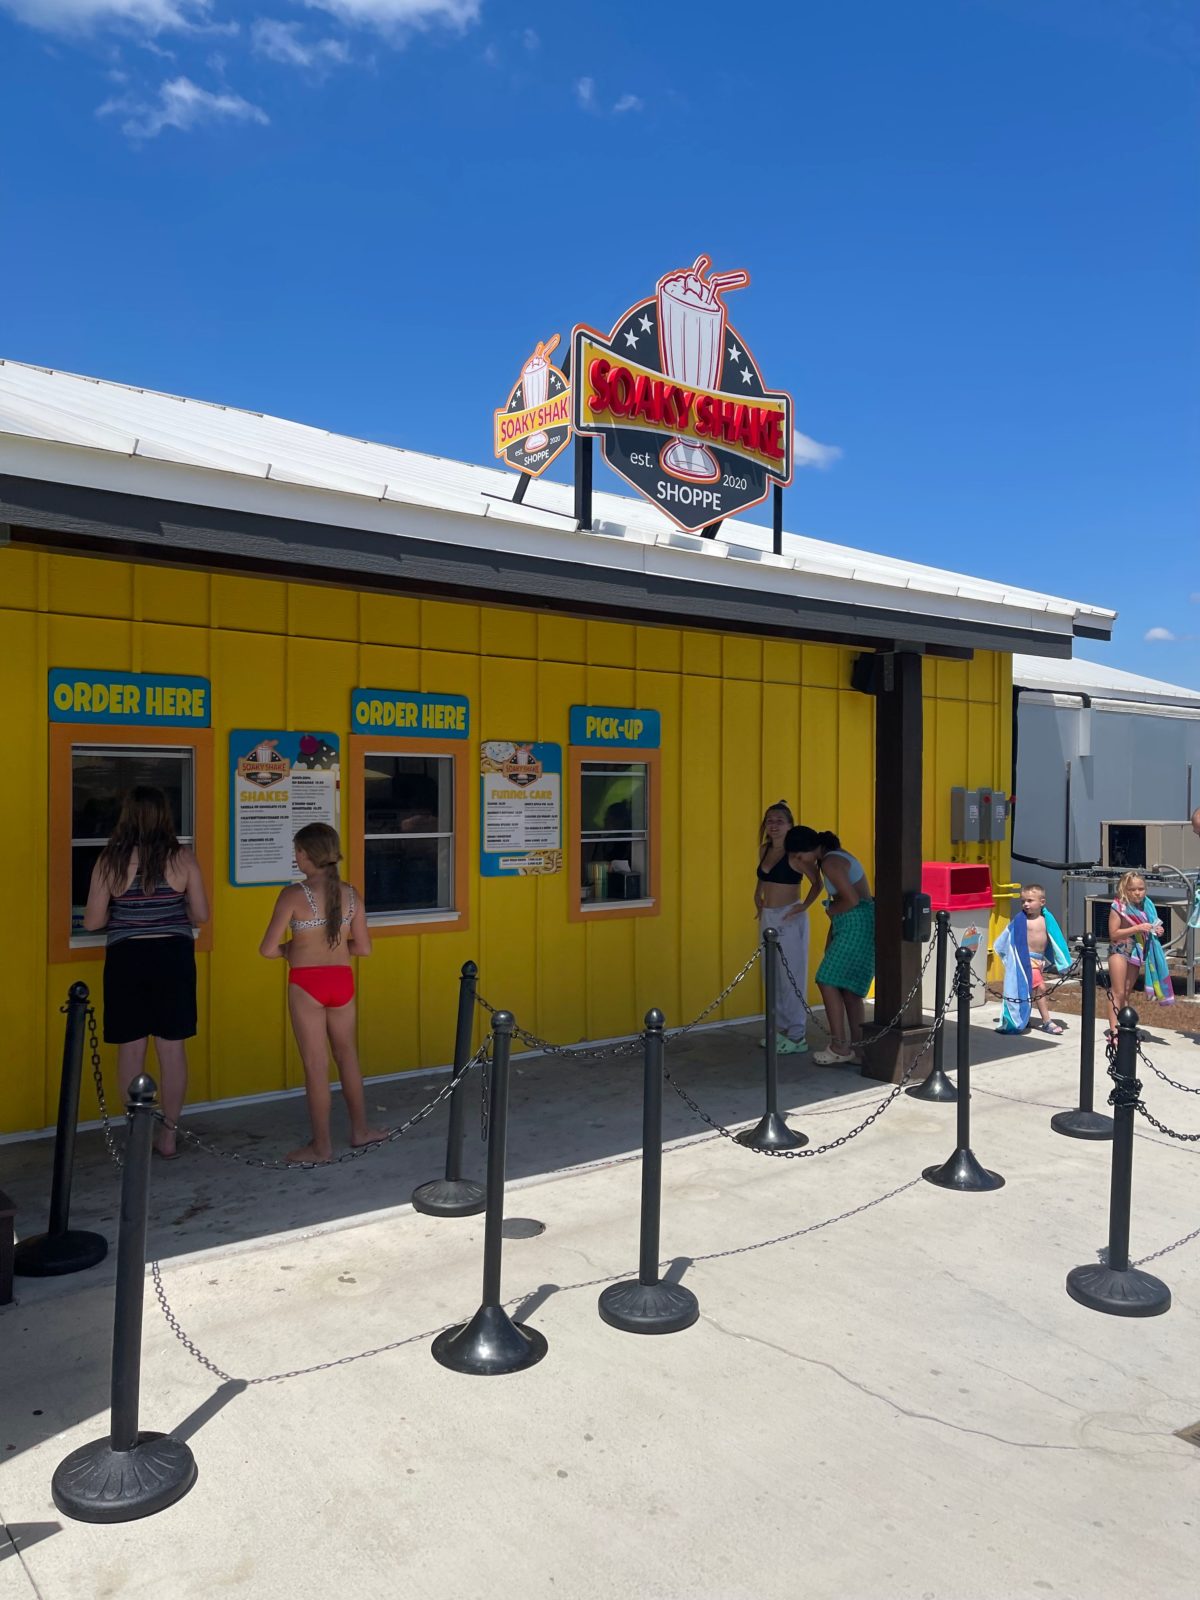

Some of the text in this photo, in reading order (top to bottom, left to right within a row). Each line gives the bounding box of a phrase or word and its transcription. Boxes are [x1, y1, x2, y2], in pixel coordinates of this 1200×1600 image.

[501, 396, 570, 442] SOAKY SHAK
[588, 358, 785, 461] SOAKY SHAKE
[549, 435, 561, 444] 2020
[523, 449, 549, 466] SHOPPE
[630, 452, 747, 490] est. 2020
[656, 480, 722, 511] SHOPPE
[54, 682, 205, 717] ORDER HERE
[355, 700, 466, 730] ORDER HERE
[586, 715, 644, 740] PICK-UP
[240, 790, 288, 802] SHAKES
